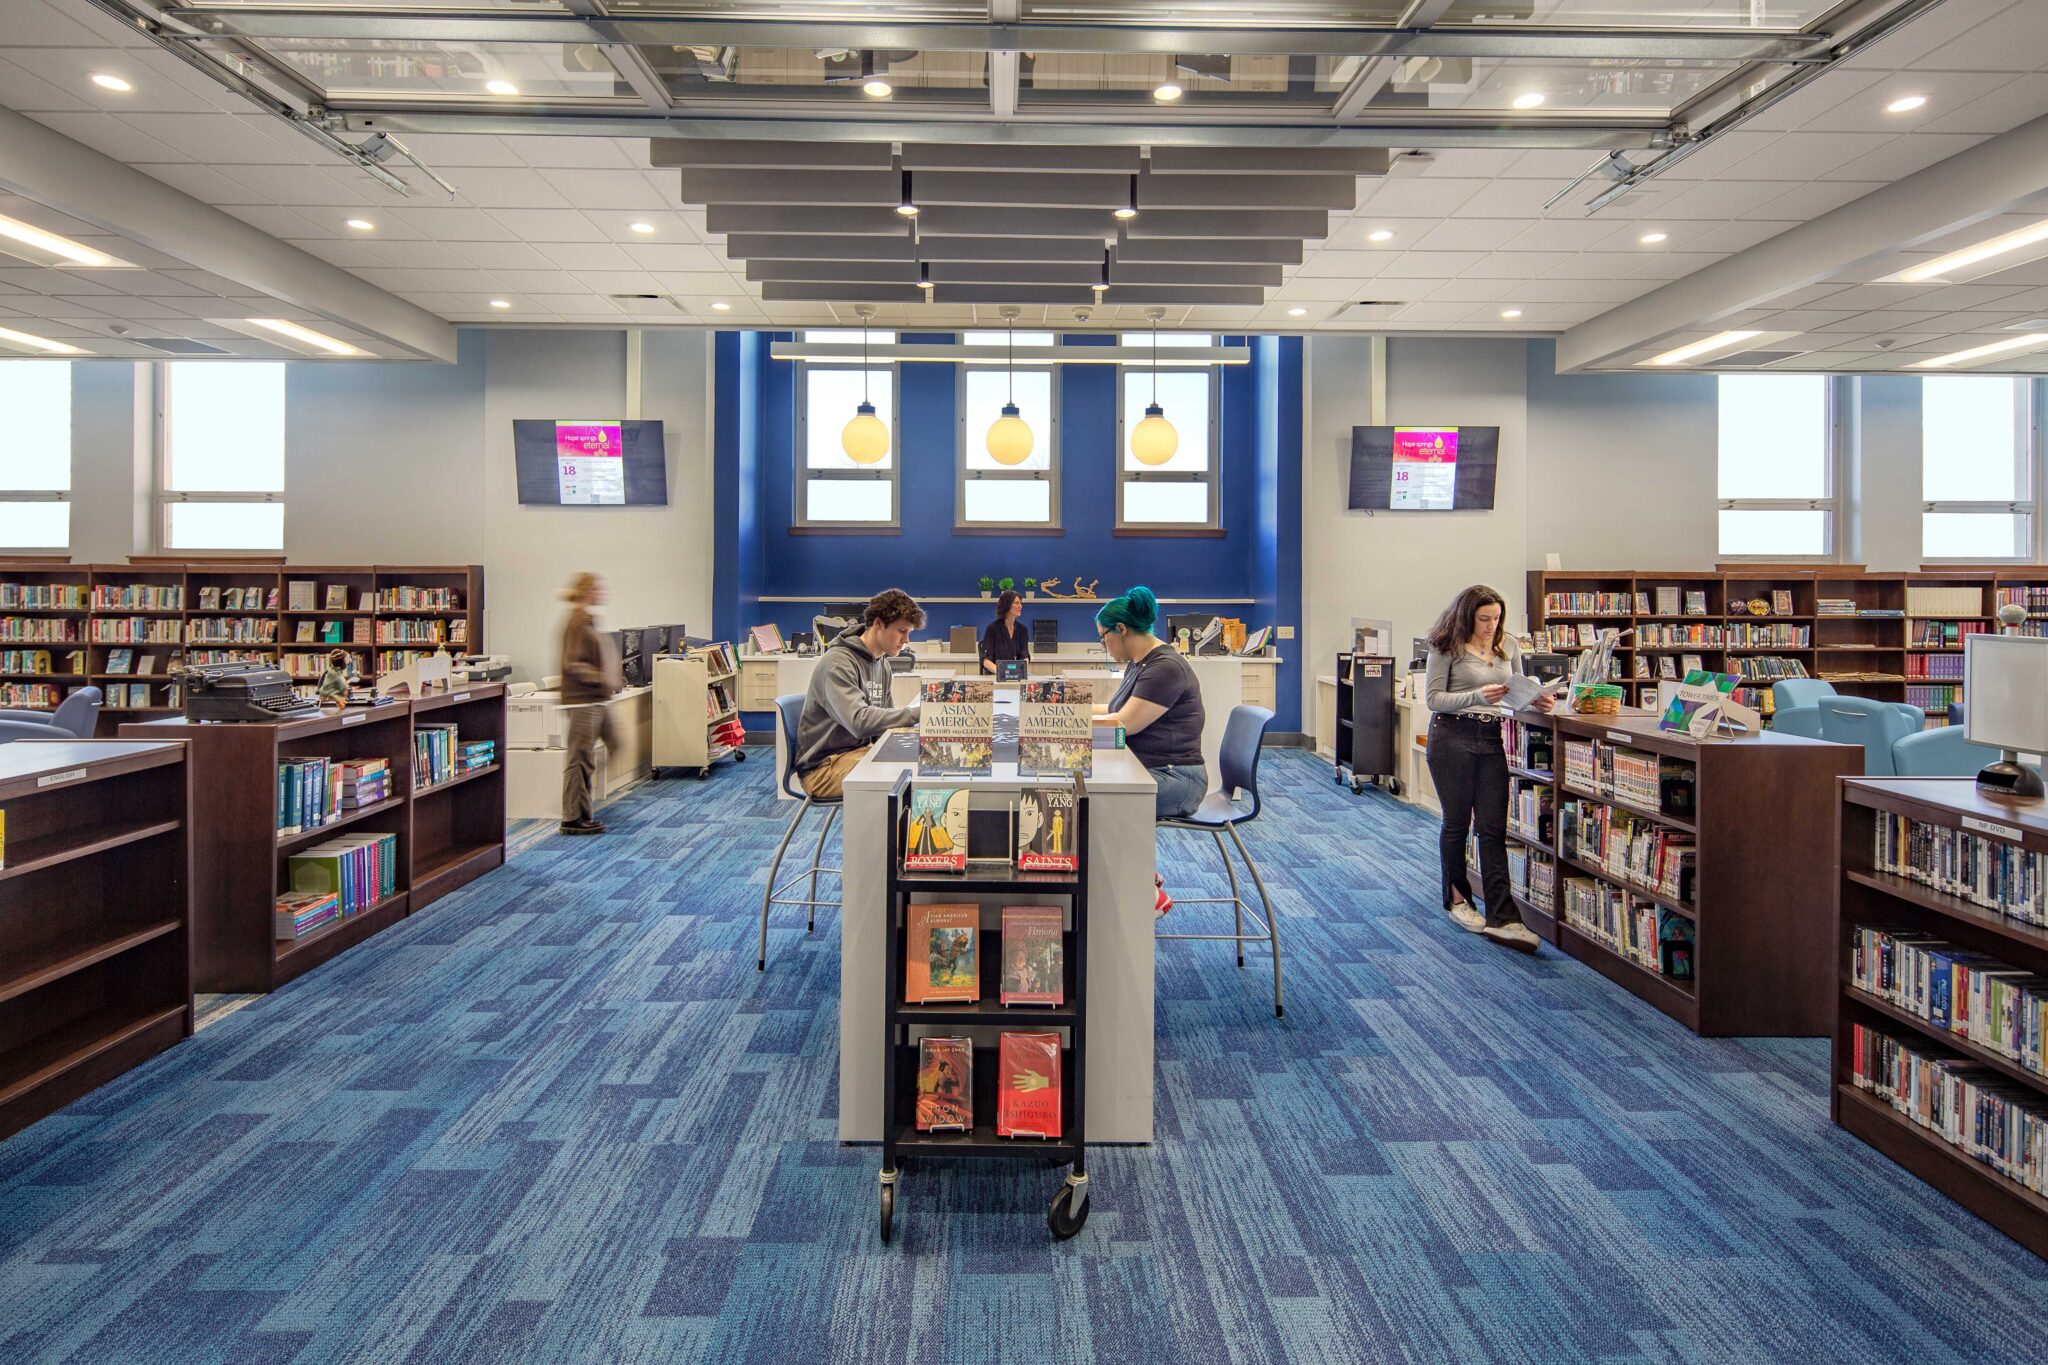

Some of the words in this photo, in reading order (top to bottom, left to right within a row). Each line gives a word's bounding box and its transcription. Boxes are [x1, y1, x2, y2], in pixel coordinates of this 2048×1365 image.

[565, 434, 579, 442] Hope
[1402, 440, 1416, 448] Hope
[562, 466, 576, 476] 18
[1395, 471, 1409, 481] 18
[1680, 691, 1701, 700] TOWER
[941, 705, 976, 715] ASIAN
[1040, 705, 1075, 716] ASIAN
[926, 716, 990, 727] AMERICAN
[1025, 716, 1089, 728] AMERICAN
[50, 772, 75, 781] ENGLISH
[917, 799, 941, 808] YANG
[1047, 798, 1073, 807] YANG
[1990, 824, 2006, 834] DVD
[1025, 856, 1072, 866] SAINTS
[1013, 1100, 1049, 1108] KAZUO
[930, 1105, 959, 1113] IRON
[922, 1114, 965, 1123] WIDOW
[1005, 1110, 1056, 1119] ISHIGURO
